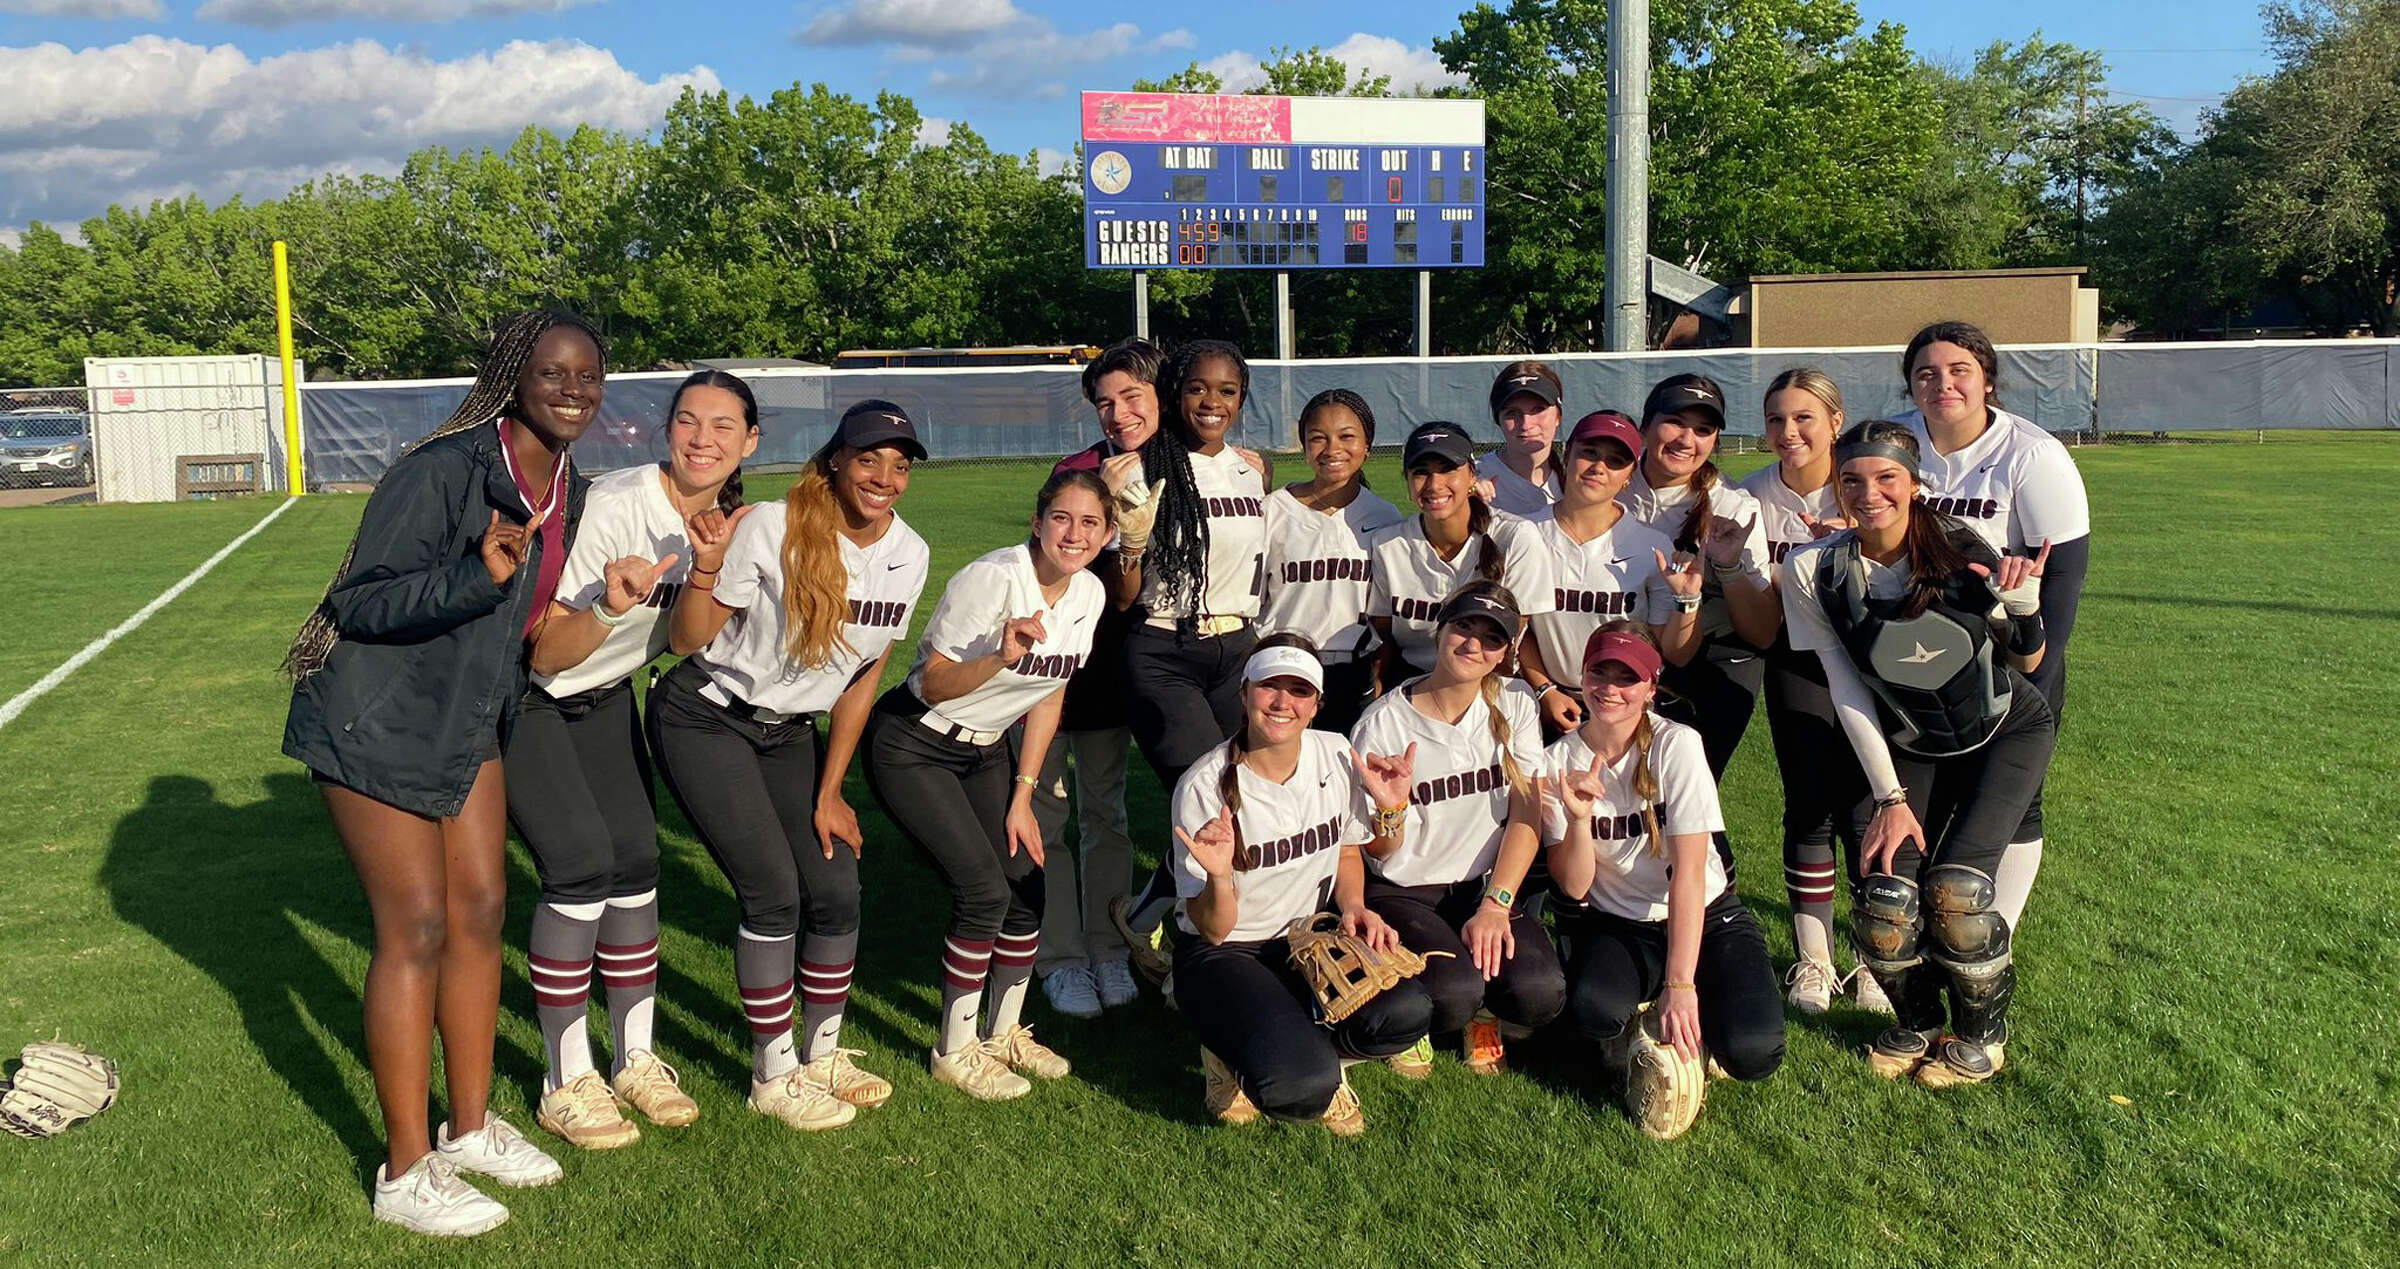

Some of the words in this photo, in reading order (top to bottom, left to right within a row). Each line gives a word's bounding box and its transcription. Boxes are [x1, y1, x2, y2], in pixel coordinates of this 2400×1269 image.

[1165, 147, 1180, 169] AT
[1186, 147, 1212, 169] BAT
[1252, 148, 1284, 170] BALL
[1311, 148, 1360, 171] STRIKE
[1381, 150, 1407, 172] OUT
[1431, 150, 1441, 172] H
[1463, 150, 1471, 172] E
[1181, 208, 1187, 221] 1
[1195, 208, 1202, 221] 2
[1210, 208, 1217, 221] 3
[1224, 208, 1231, 221] 4
[1239, 208, 1246, 221] 5
[1267, 208, 1274, 221] 7
[1344, 208, 1368, 221] RUNS
[1396, 208, 1416, 221] HITS
[1441, 208, 1473, 221] ERRORS
[1098, 220, 1169, 243] GUESTS
[1100, 243, 1169, 265] RANGERS
[1924, 497, 1998, 519] HORNS
[1281, 558, 1372, 584] ONGHORN
[846, 599, 907, 627] HORNS
[1409, 764, 1511, 806] LONGHOR
[1246, 812, 1342, 871] ONGHORN
